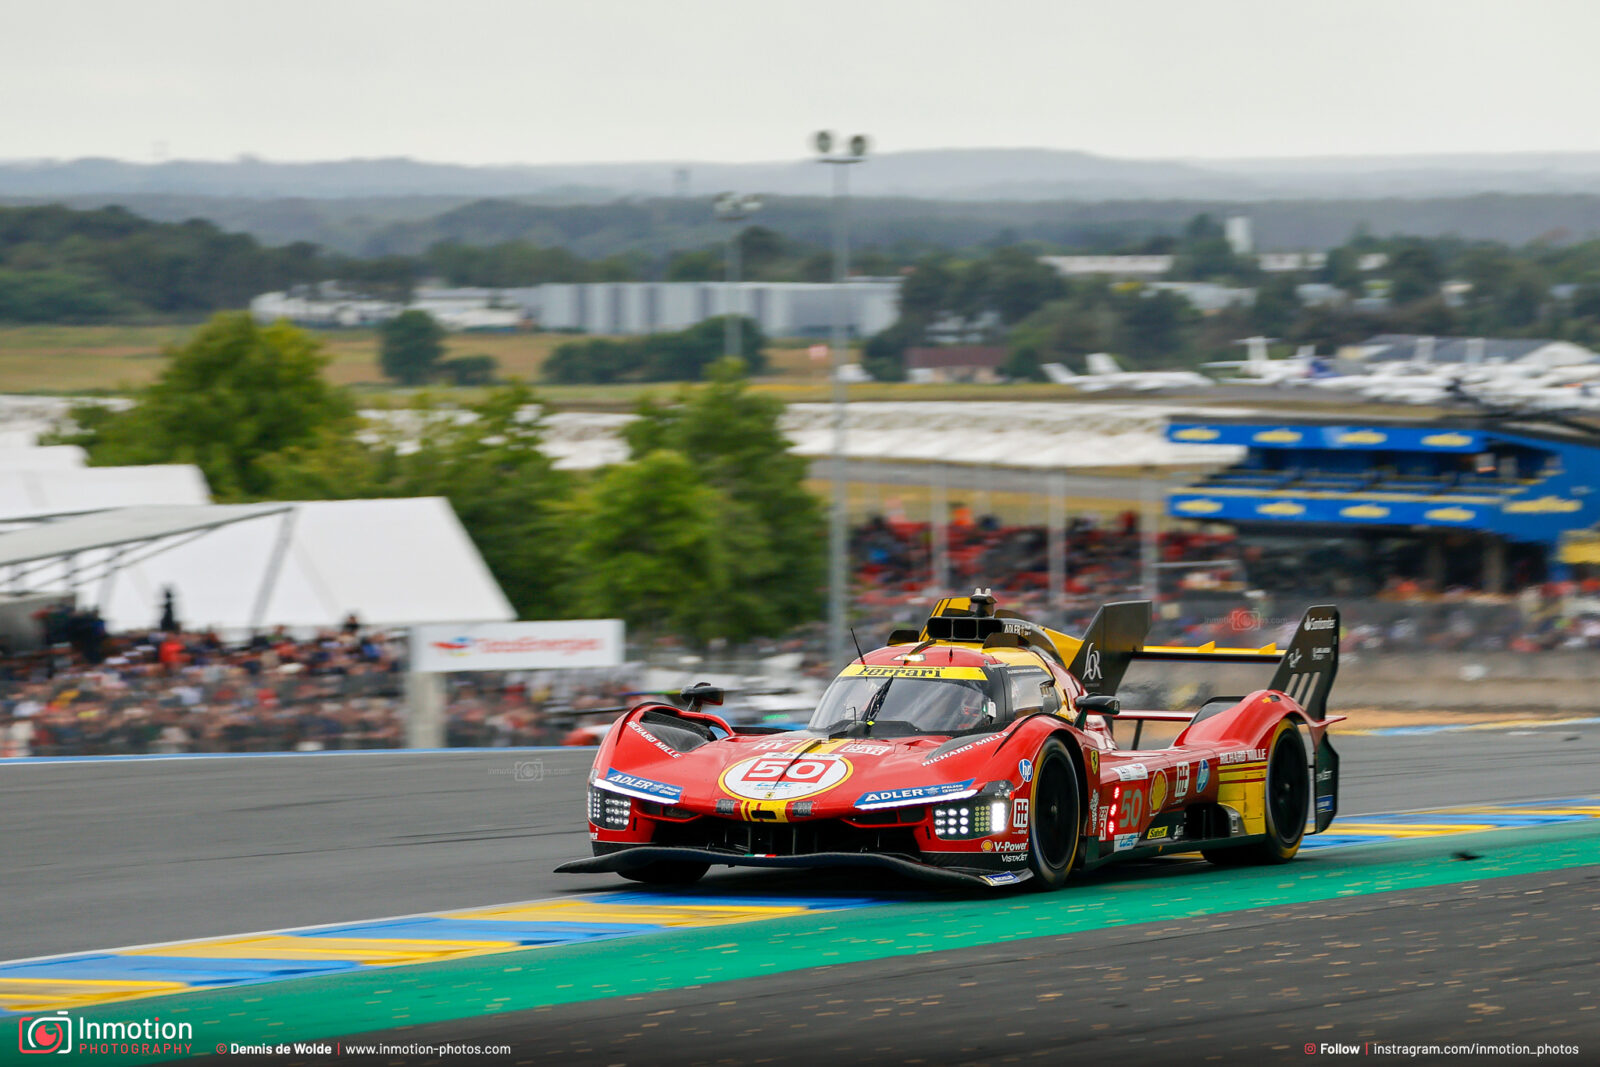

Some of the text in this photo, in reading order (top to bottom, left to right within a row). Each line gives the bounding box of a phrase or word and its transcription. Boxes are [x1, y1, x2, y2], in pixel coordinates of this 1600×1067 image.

[1004, 624, 1021, 635] ADLER
[856, 666, 945, 678] Ferrari
[626, 721, 683, 759] RICHARD MILLE
[922, 731, 1009, 767] RICHARD MILLE
[748, 760, 826, 780] 50
[1022, 760, 1032, 781] hp
[607, 774, 654, 790] ADLER
[864, 788, 924, 803] ADLER
[1119, 788, 1143, 828] 50
[994, 841, 1028, 852] V-Power
